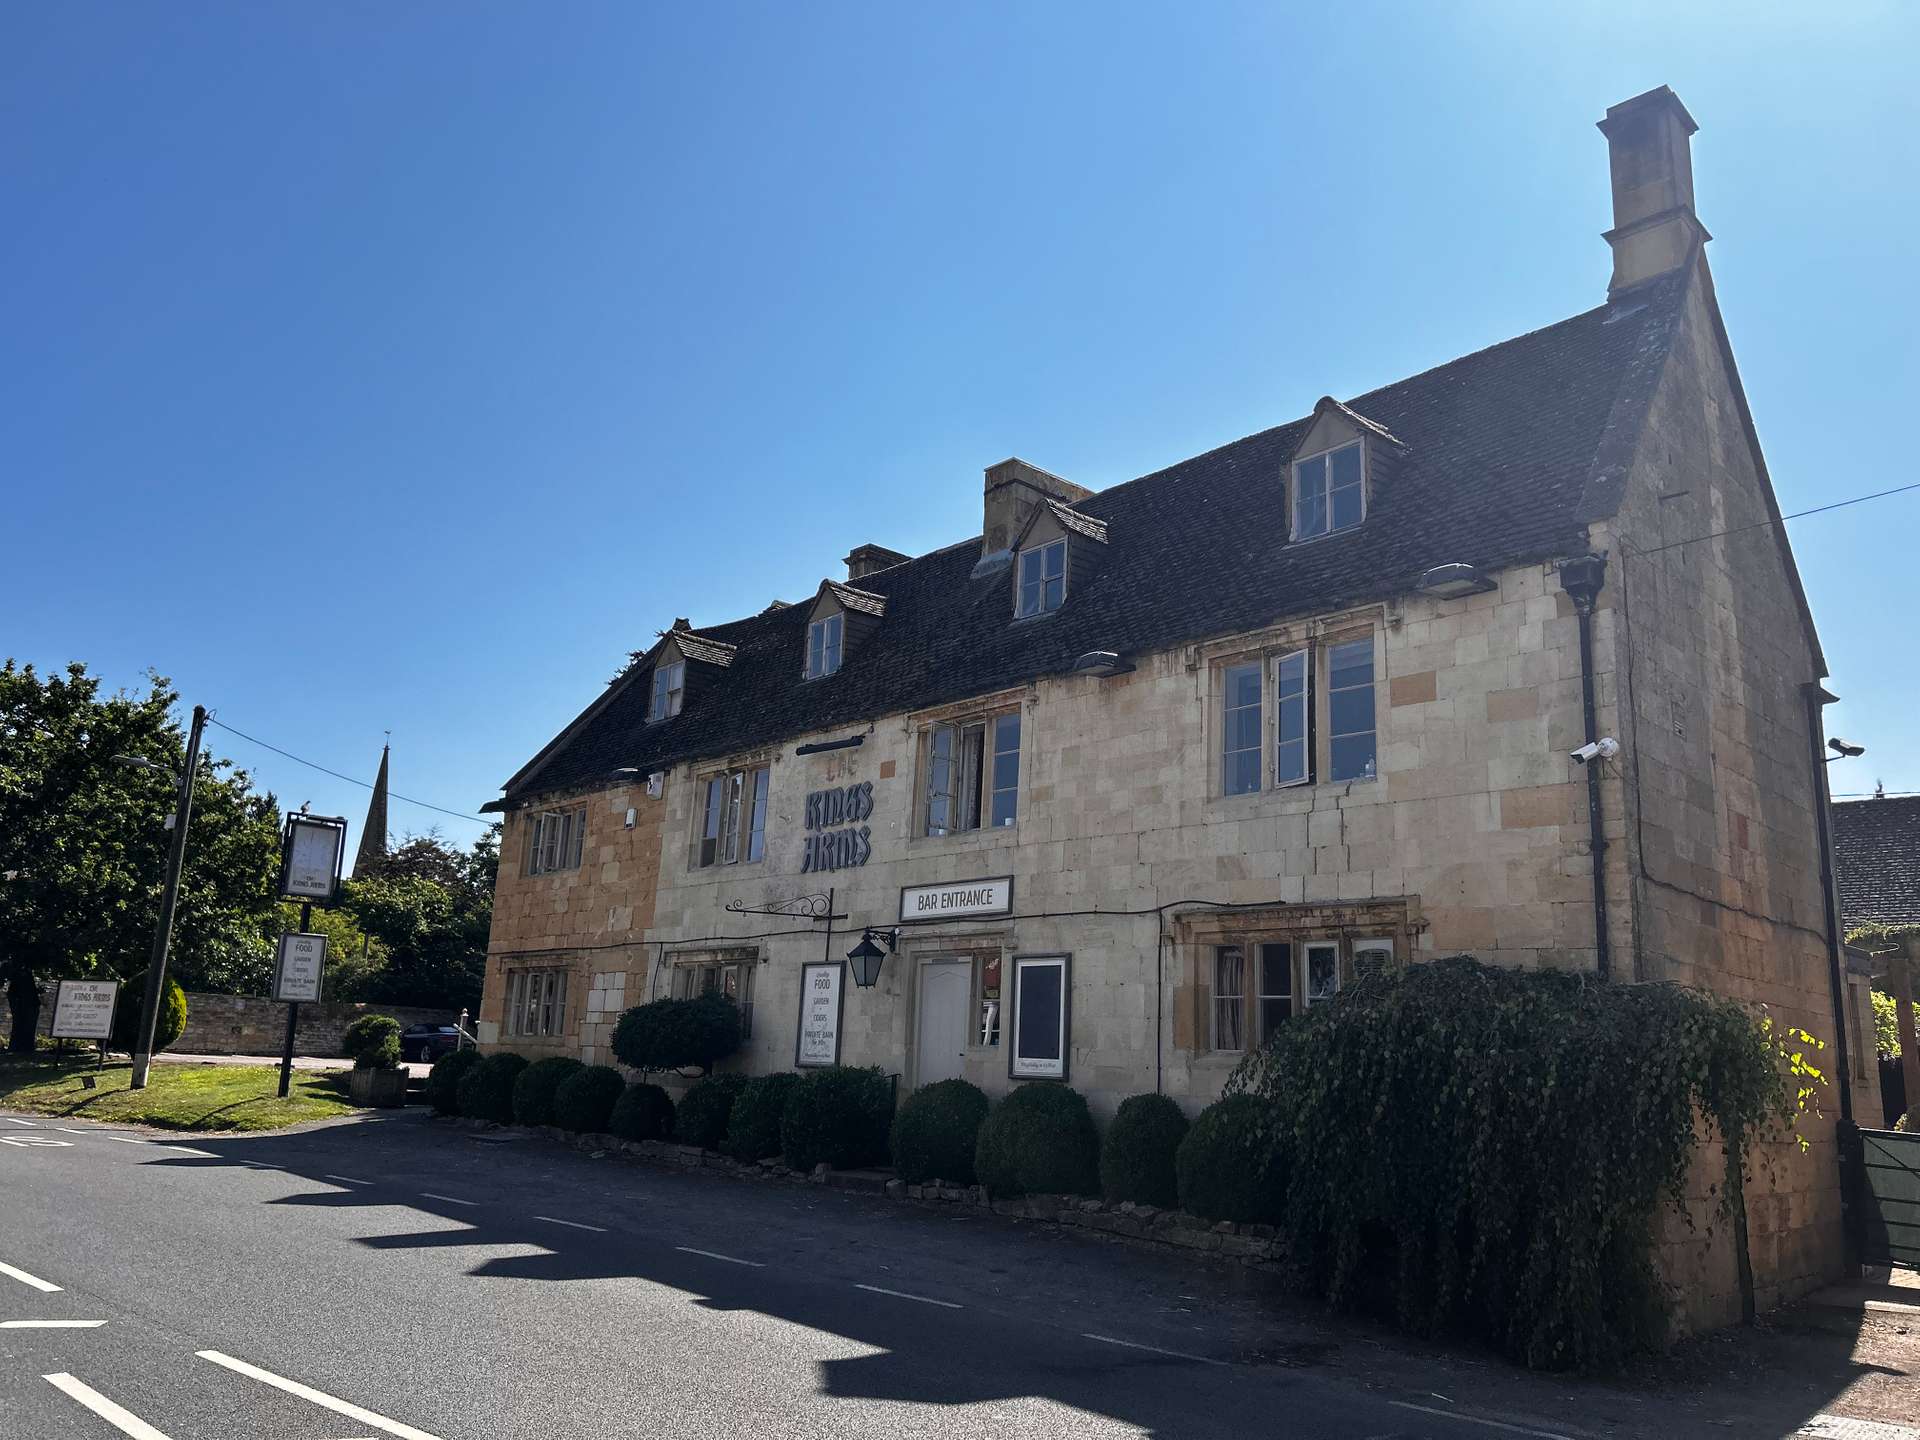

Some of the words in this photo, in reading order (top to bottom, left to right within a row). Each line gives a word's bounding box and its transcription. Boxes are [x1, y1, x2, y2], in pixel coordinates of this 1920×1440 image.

[804, 781, 874, 833] KINGS
[800, 825, 872, 874] ARMS
[918, 893, 938, 911] BAR
[941, 888, 993, 909] ENTRANCE
[295, 943, 313, 953] FOOD
[814, 978, 831, 990] FOOD
